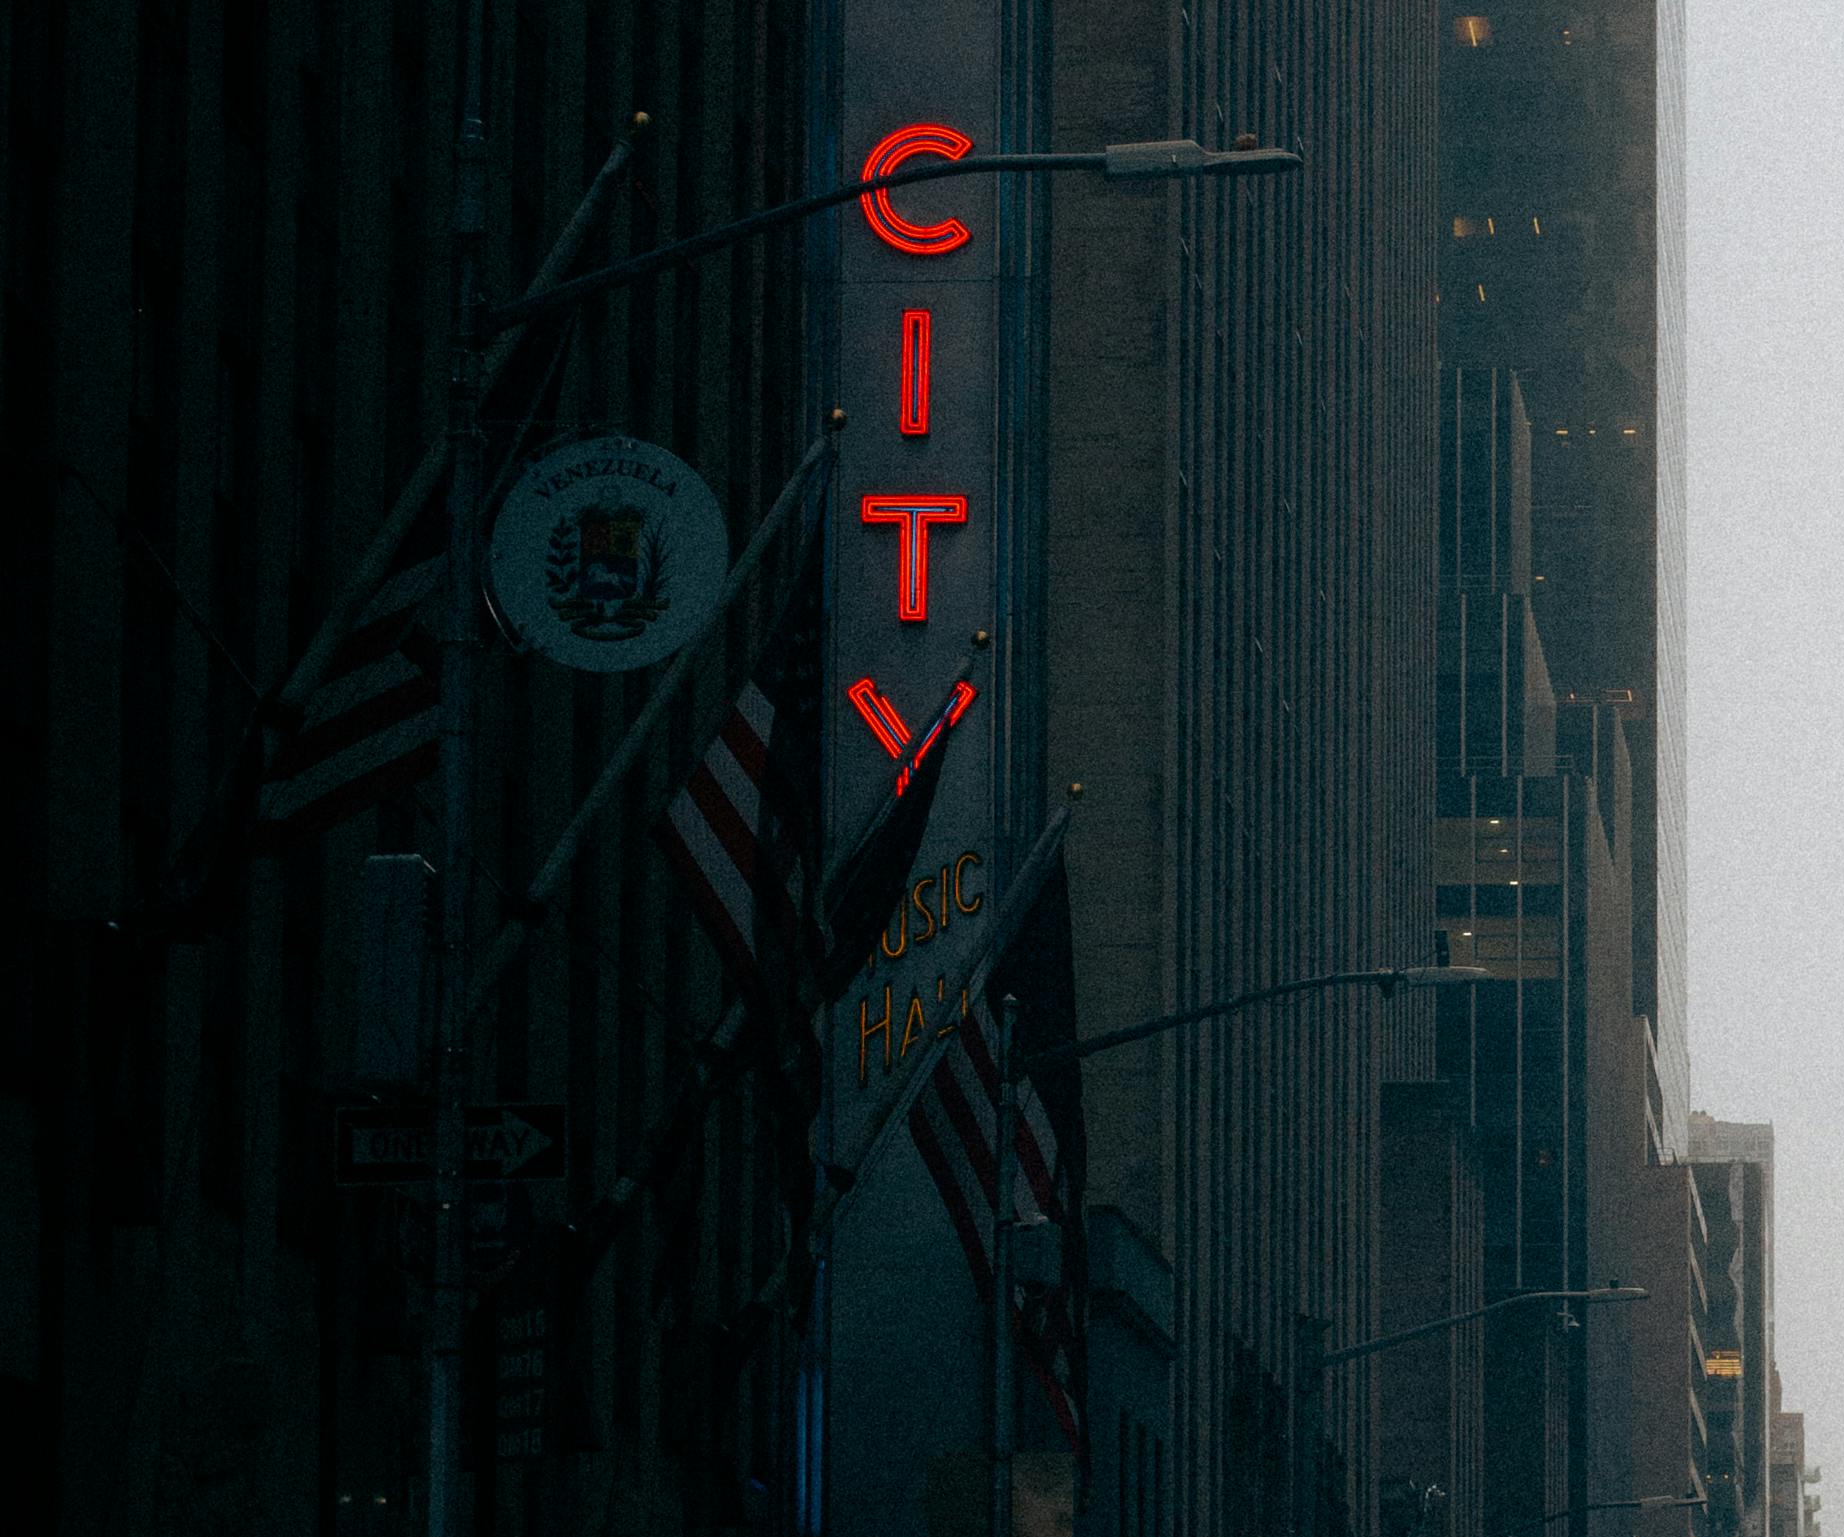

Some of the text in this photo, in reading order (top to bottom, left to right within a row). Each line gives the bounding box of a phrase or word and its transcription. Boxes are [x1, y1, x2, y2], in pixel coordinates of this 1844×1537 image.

[537, 459, 677, 498] VENEZUELA
[847, 124, 977, 796] CITY
[866, 850, 983, 969] USIC
